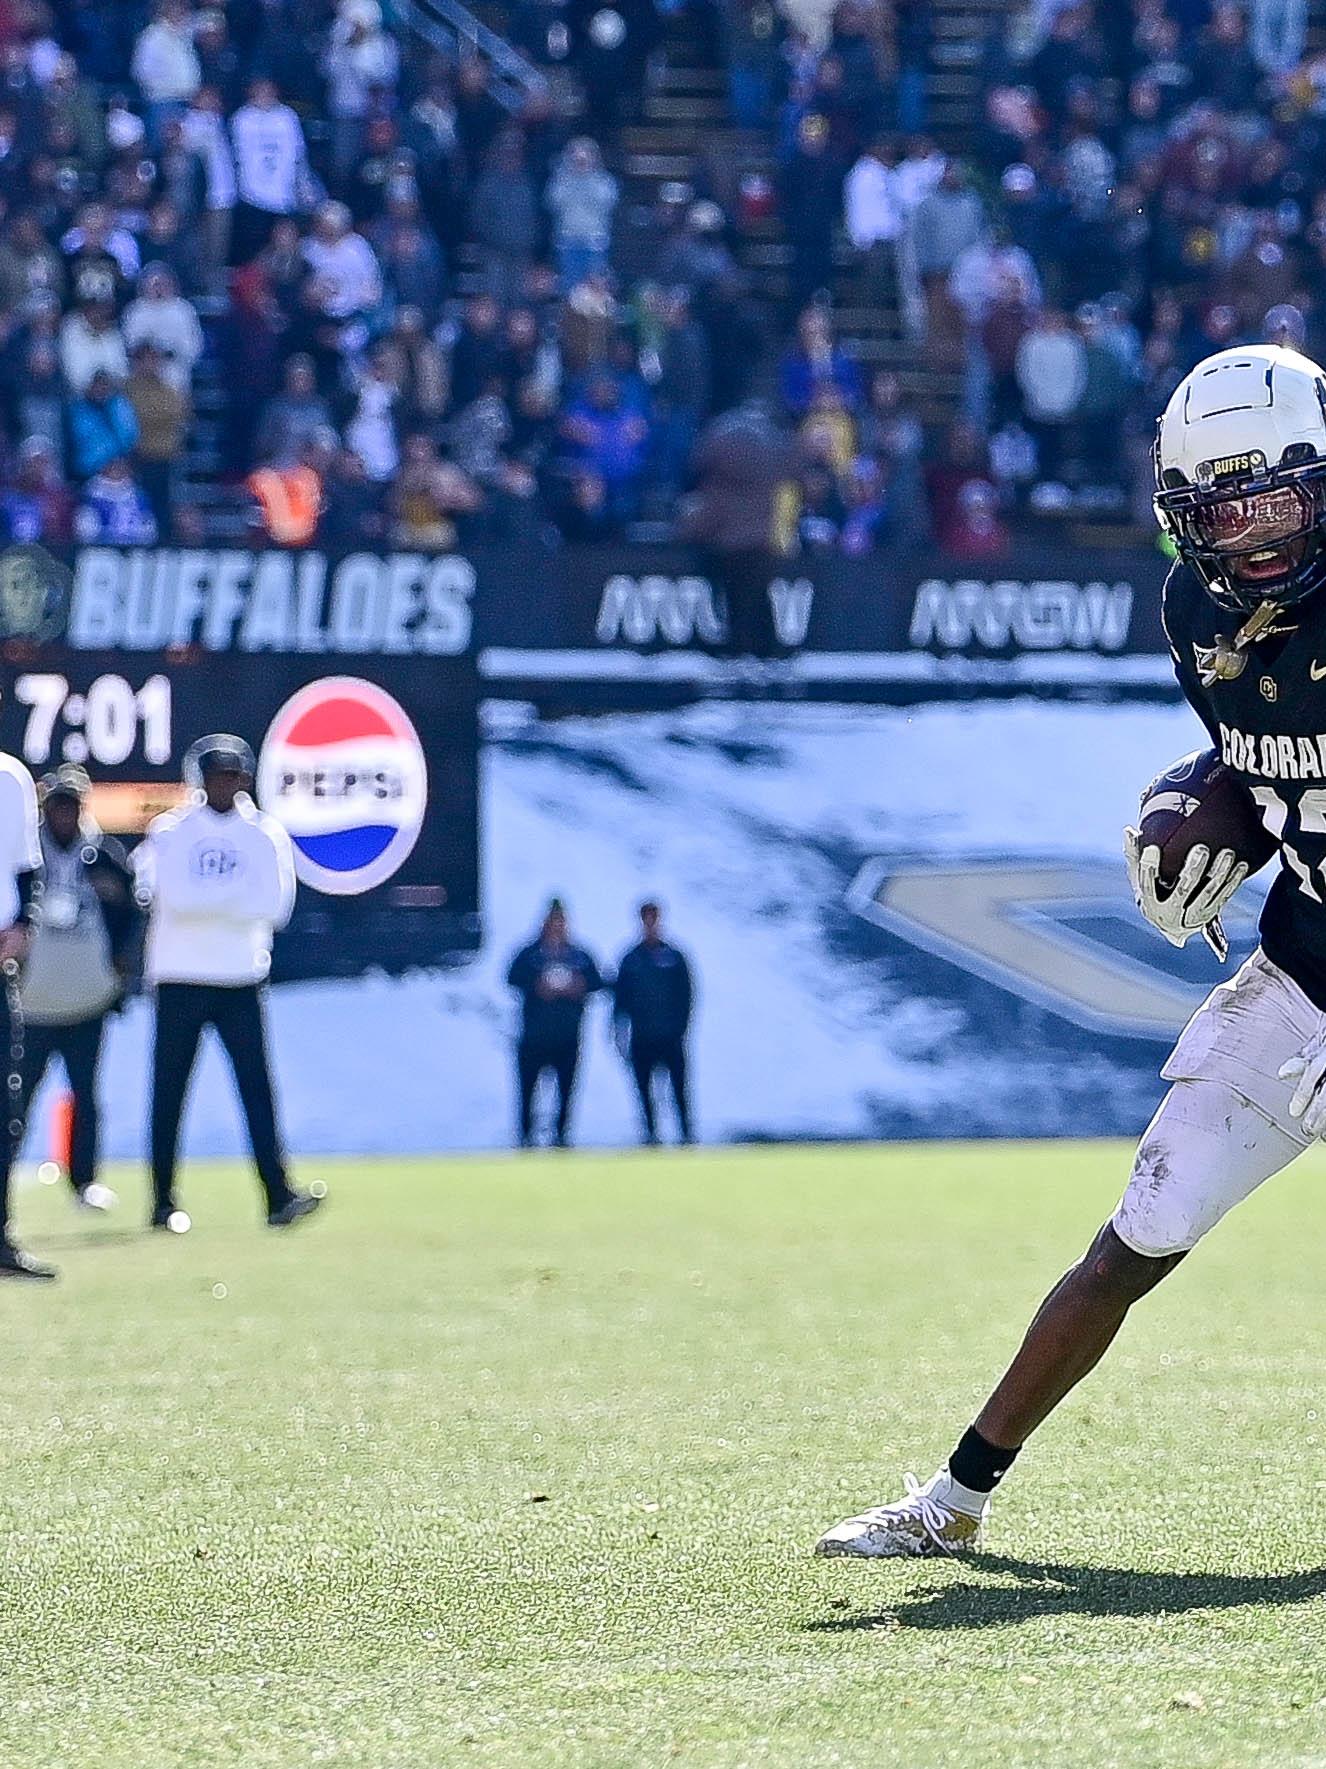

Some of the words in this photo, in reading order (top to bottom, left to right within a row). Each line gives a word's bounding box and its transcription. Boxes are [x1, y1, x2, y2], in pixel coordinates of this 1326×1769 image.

[1214, 455, 1249, 475] BUFFS
[70, 549, 477, 655] BUFFALOES
[596, 575, 814, 646] ARRW
[910, 579, 1134, 648] ARROW
[15, 674, 172, 765] 7:01
